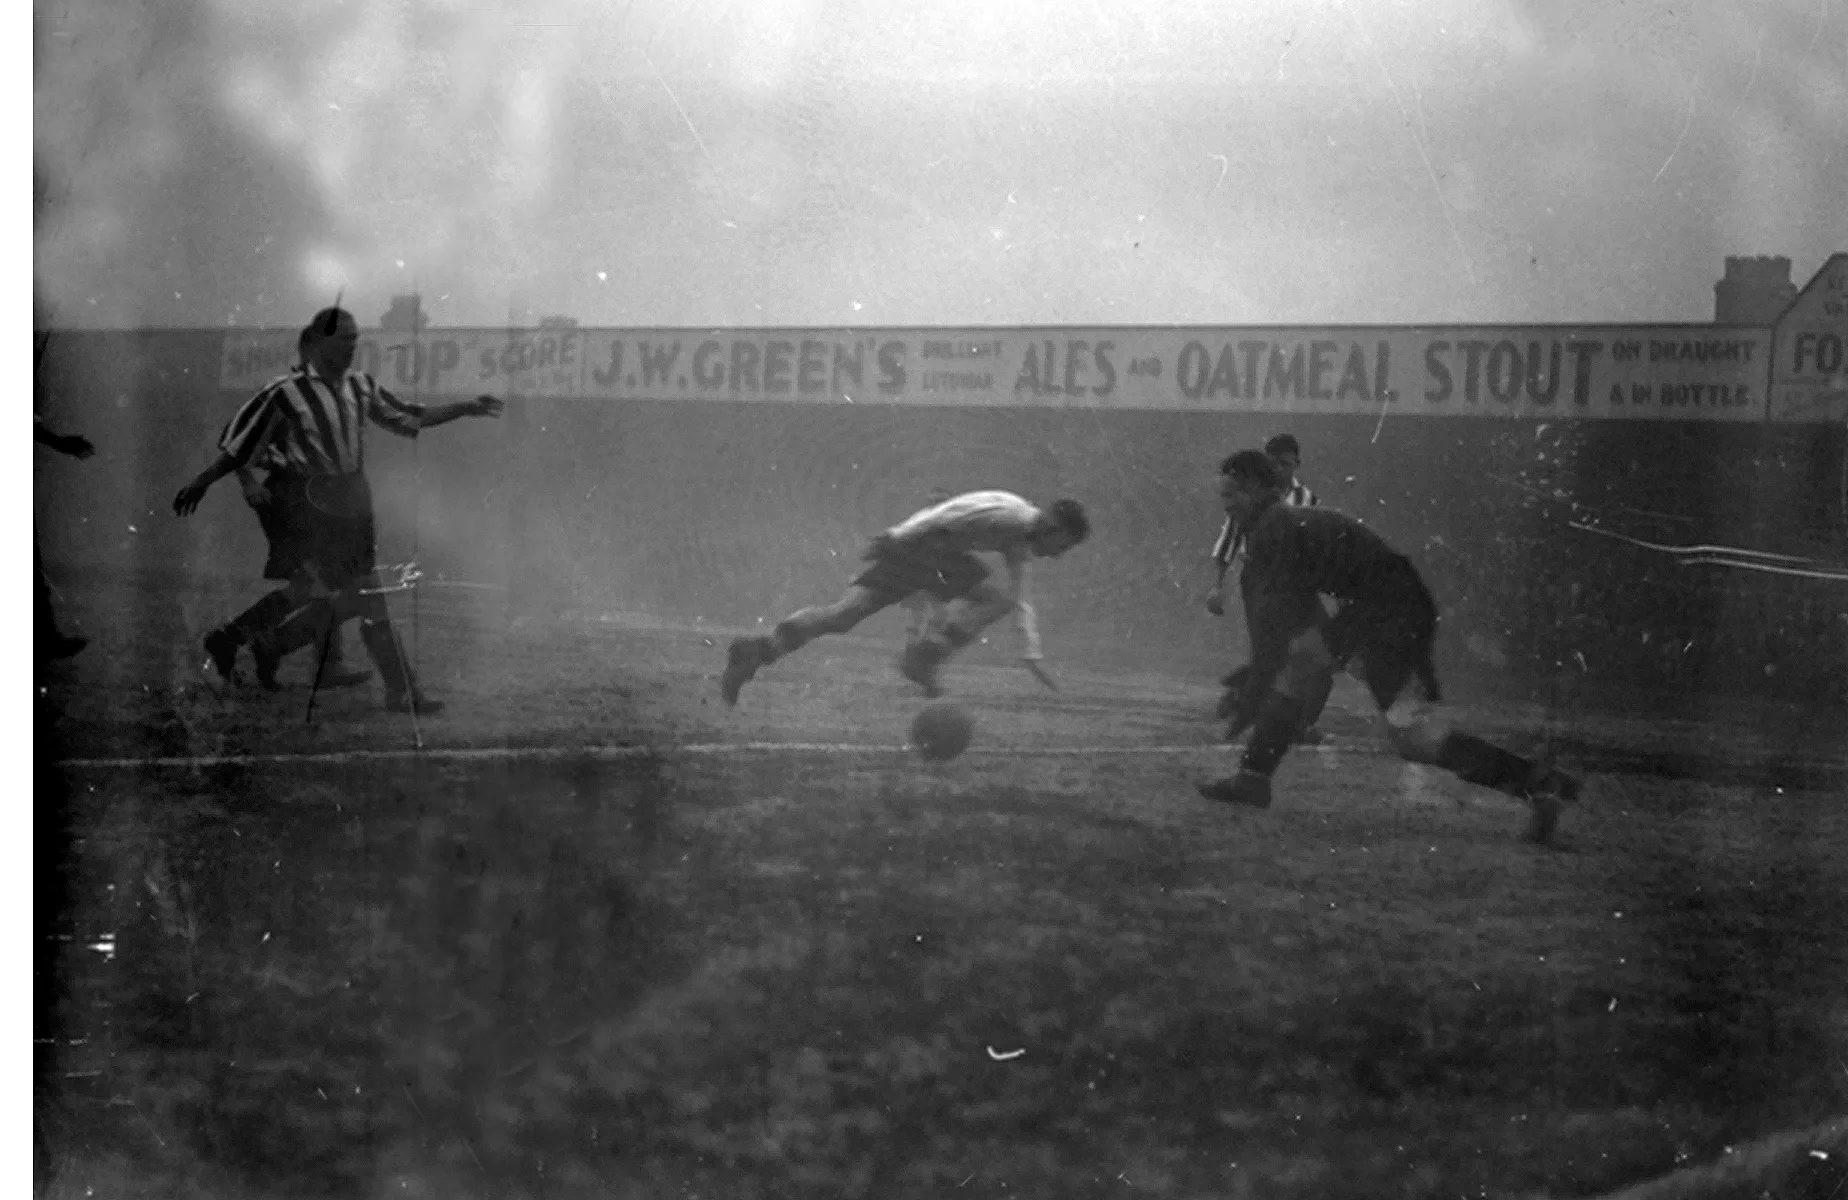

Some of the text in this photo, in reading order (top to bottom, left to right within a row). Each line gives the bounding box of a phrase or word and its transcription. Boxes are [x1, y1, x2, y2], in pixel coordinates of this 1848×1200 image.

[1014, 339, 1118, 398] ALES
[1177, 339, 1399, 403] OATMEAL
[1423, 339, 1605, 407] STOUT
[1612, 340, 1756, 363] ON DRAUGHT
